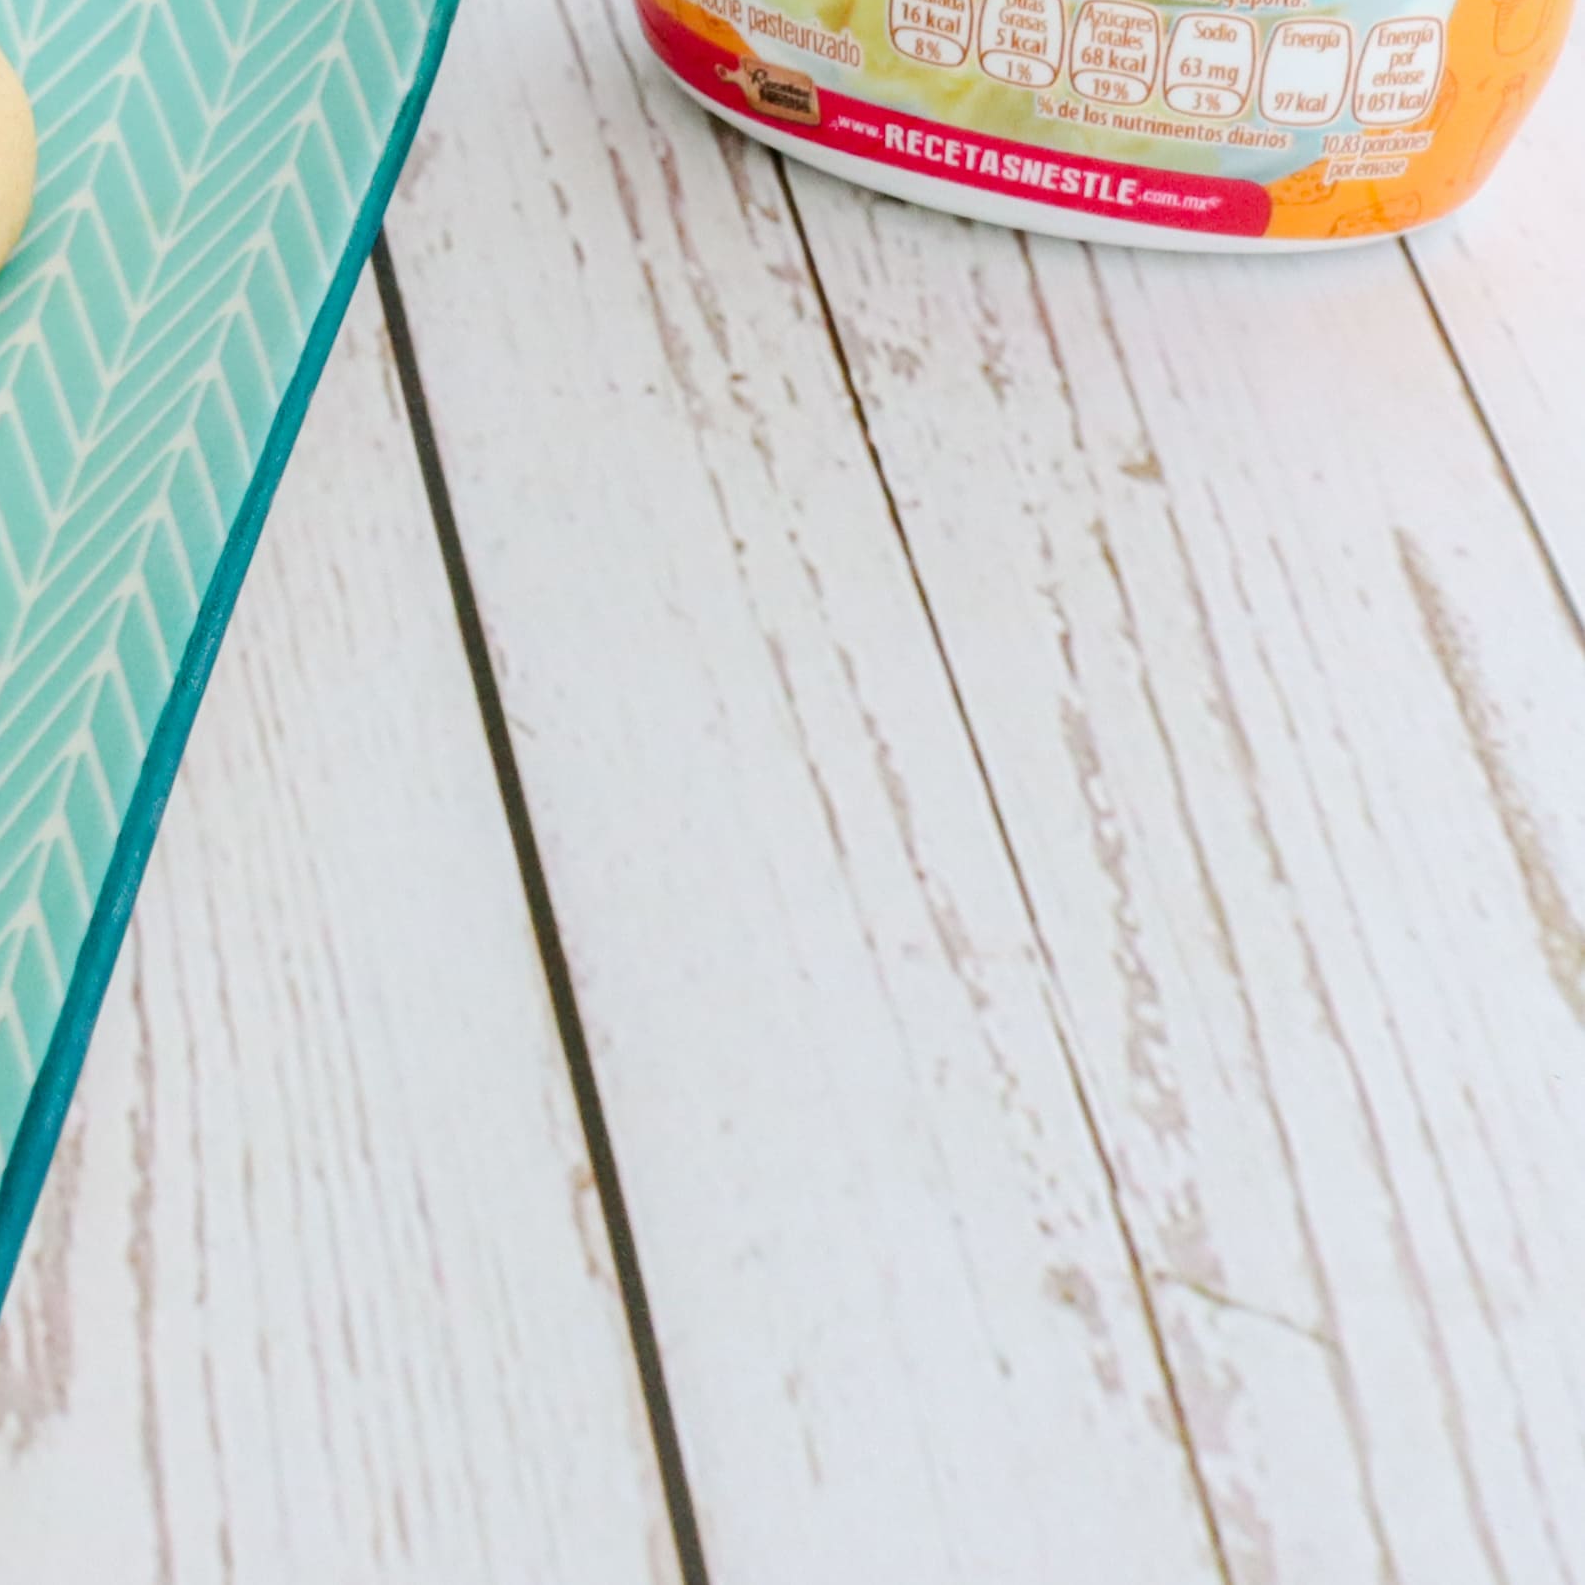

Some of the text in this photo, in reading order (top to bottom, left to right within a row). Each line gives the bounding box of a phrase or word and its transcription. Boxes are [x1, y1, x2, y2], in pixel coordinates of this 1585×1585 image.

[902, 3, 961, 35] 16 kcal
[999, 8, 1048, 32] Grasas
[1084, 4, 1154, 32] Azúcares
[748, 5, 861, 67] pasteurizado
[996, 29, 1047, 55] 5 kcal
[1090, 28, 1144, 50] Totales
[1192, 21, 1237, 43] Sodio
[1282, 27, 1340, 51] Energía
[1378, 26, 1433, 50] Energía
[1081, 46, 1147, 74] 68 kcal
[1180, 57, 1239, 86] 63 mg
[1388, 49, 1414, 72] por
[1372, 70, 1425, 85] envase
[1274, 93, 1328, 112] 97 kcal
[1398, 91, 1428, 111] kcal
[1037, 95, 1287, 149] % de los nutrimentos diarios
